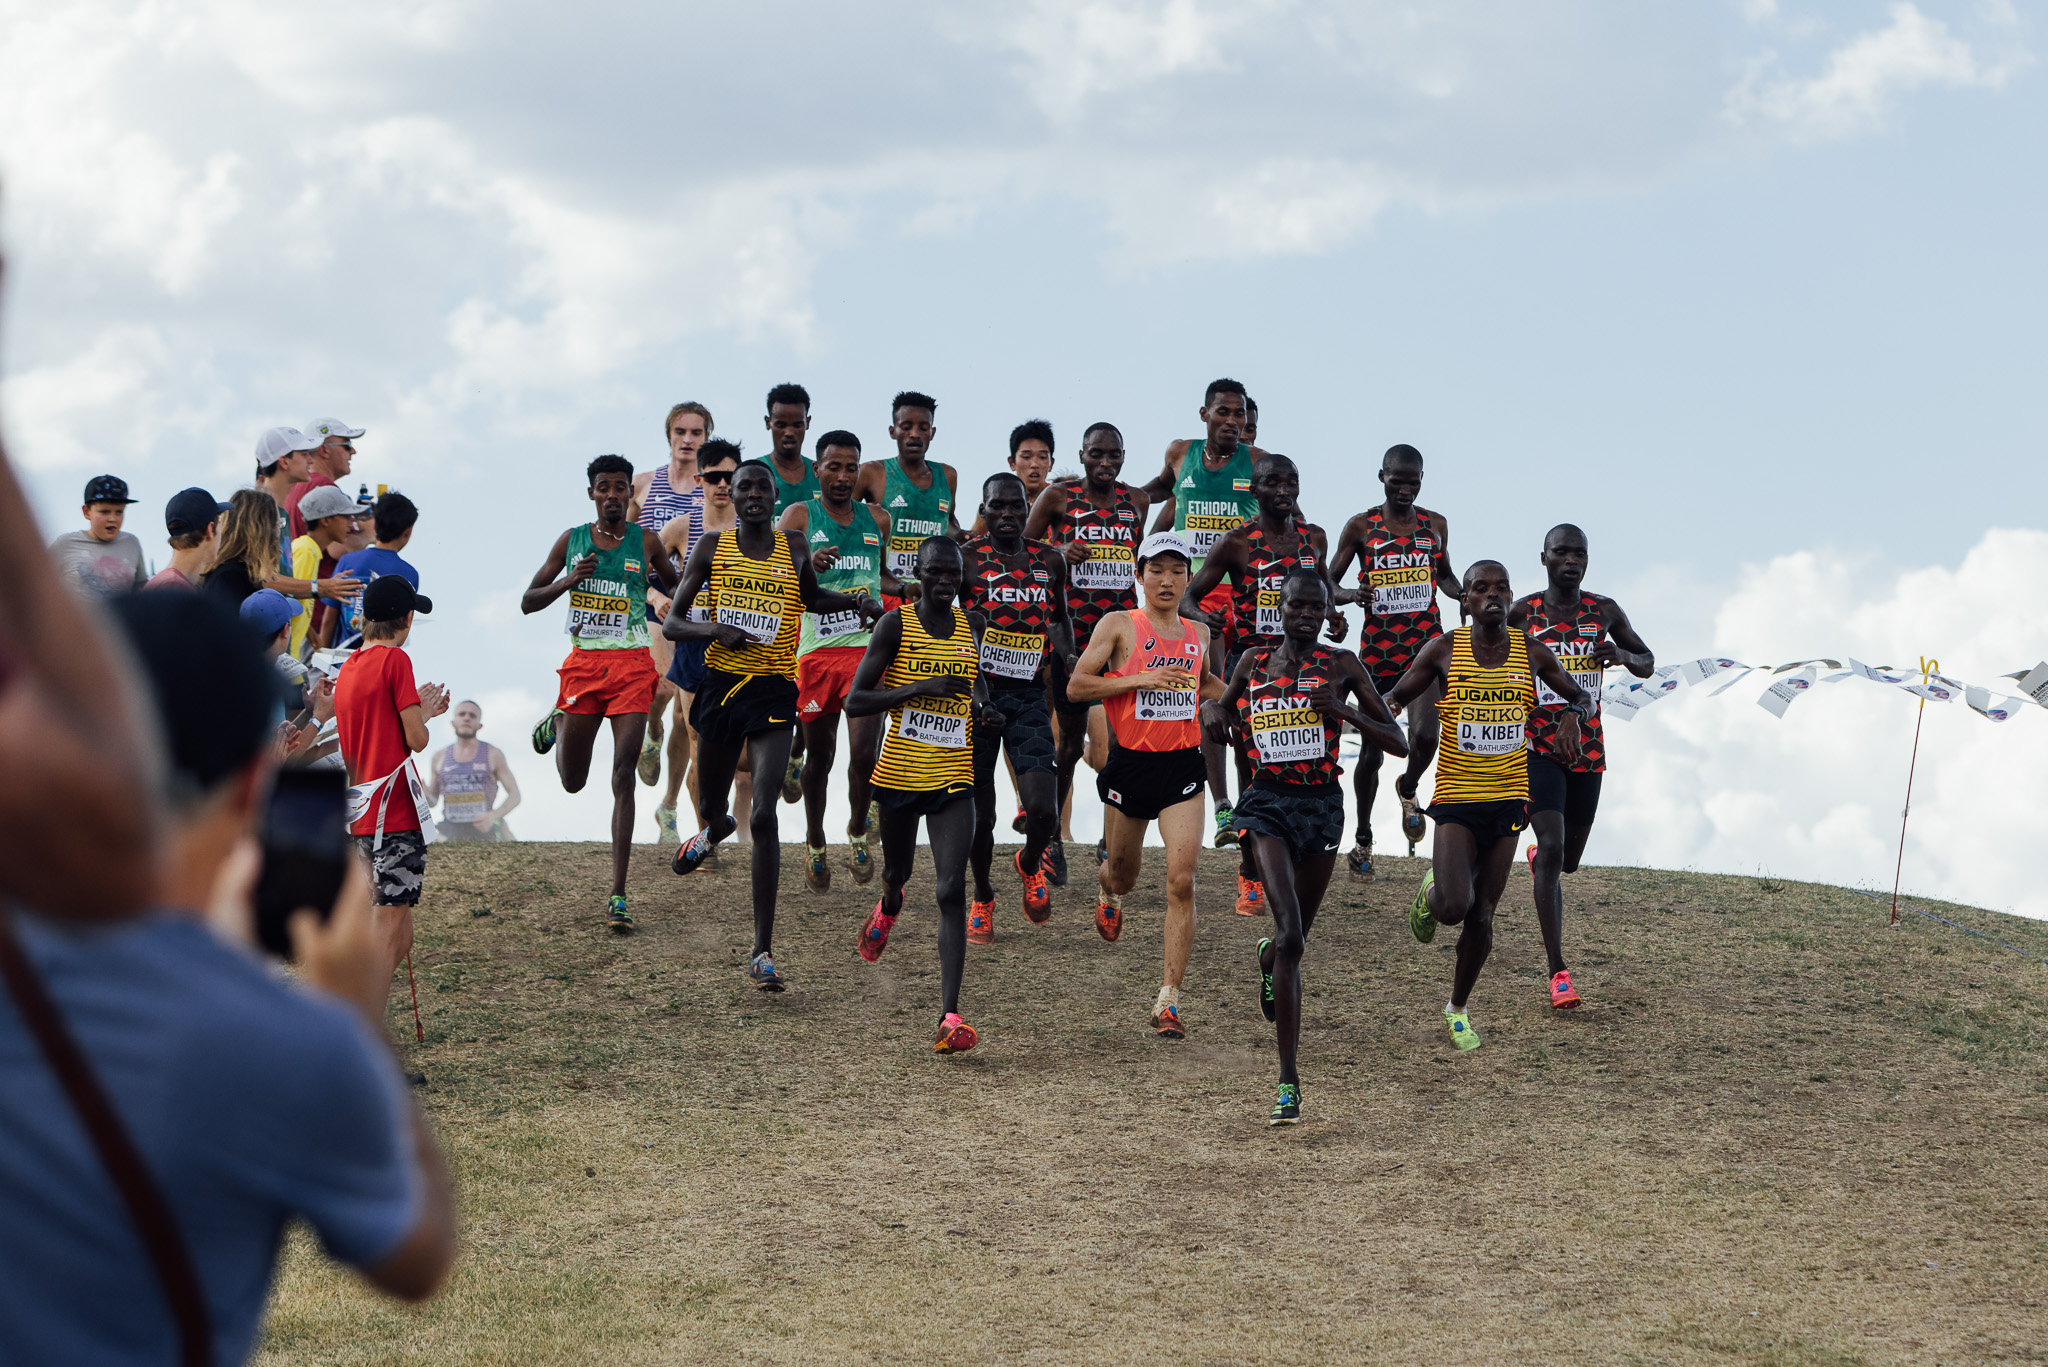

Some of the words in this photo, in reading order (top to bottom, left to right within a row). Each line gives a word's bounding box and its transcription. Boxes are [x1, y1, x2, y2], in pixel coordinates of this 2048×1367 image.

[654, 508, 685, 518] GRE
[1188, 500, 1239, 516] ETHIOPIA
[896, 519, 941, 536] ETHIOPIA
[1187, 516, 1241, 530] SEIKO
[1074, 526, 1132, 541] KENYA
[891, 538, 922, 550] SEI
[1152, 538, 1183, 547] JAPAN
[1090, 548, 1132, 560] EIKO
[1374, 553, 1430, 569] KENYA
[829, 555, 871, 570] HIOPIA
[1076, 561, 1132, 576] KINYANJUI
[1372, 569, 1428, 586] SEIKO
[722, 577, 785, 595] UGANDA
[1387, 584, 1430, 601] KIPKURUI
[988, 588, 1046, 602] KENYA
[571, 594, 628, 612] SEIKO
[720, 593, 781, 614] SEIKO
[1391, 602, 1422, 611] BATHURST
[572, 610, 622, 627] BEKELE
[720, 608, 778, 632] CHEMUTAI
[820, 609, 860, 625] ZELEK
[582, 628, 614, 636] BATHURST
[833, 622, 862, 633] BATHURS
[985, 630, 1042, 649] SEIKO
[1545, 642, 1594, 656] ENYA
[908, 660, 969, 675] UGANDA
[996, 665, 1030, 676] BATHURST
[1146, 655, 1195, 671] JAPAN
[1560, 658, 1598, 670] IKO
[1572, 673, 1598, 688] URUI
[1140, 691, 1196, 706] YOSHIOK
[1457, 689, 1522, 702] UGANDA
[908, 697, 968, 716] SEIKO
[909, 711, 960, 733] KIPROP
[1253, 710, 1319, 730] SEIKO
[1461, 707, 1523, 722] SEIKO
[920, 733, 952, 743] BATHURST
[1270, 728, 1320, 747] ROTICH
[1462, 724, 1476, 740] D.
[1482, 724, 1521, 740] KIBET
[1273, 749, 1310, 759] BATHURST
[1478, 743, 1512, 751] BATHURST
